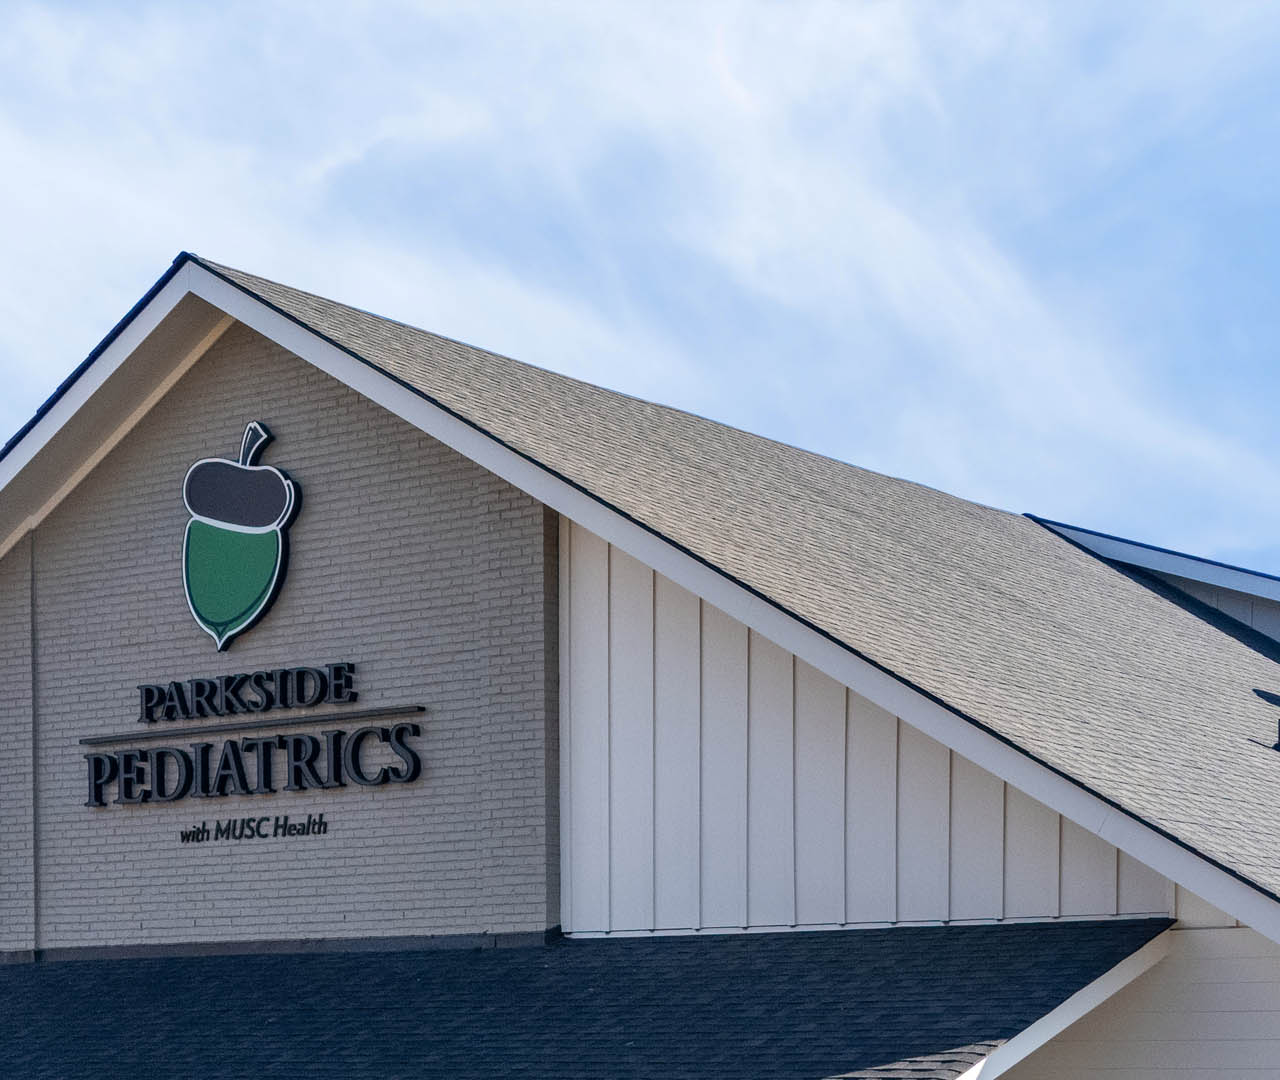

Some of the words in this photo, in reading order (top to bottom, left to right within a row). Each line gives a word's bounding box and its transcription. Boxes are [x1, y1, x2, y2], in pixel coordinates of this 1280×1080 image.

[137, 662, 358, 722] PARKSIDE
[84, 723, 422, 807] PEDIATRICS
[180, 825, 210, 844] with
[214, 816, 270, 841] MUSC
[272, 813, 328, 839] Health
